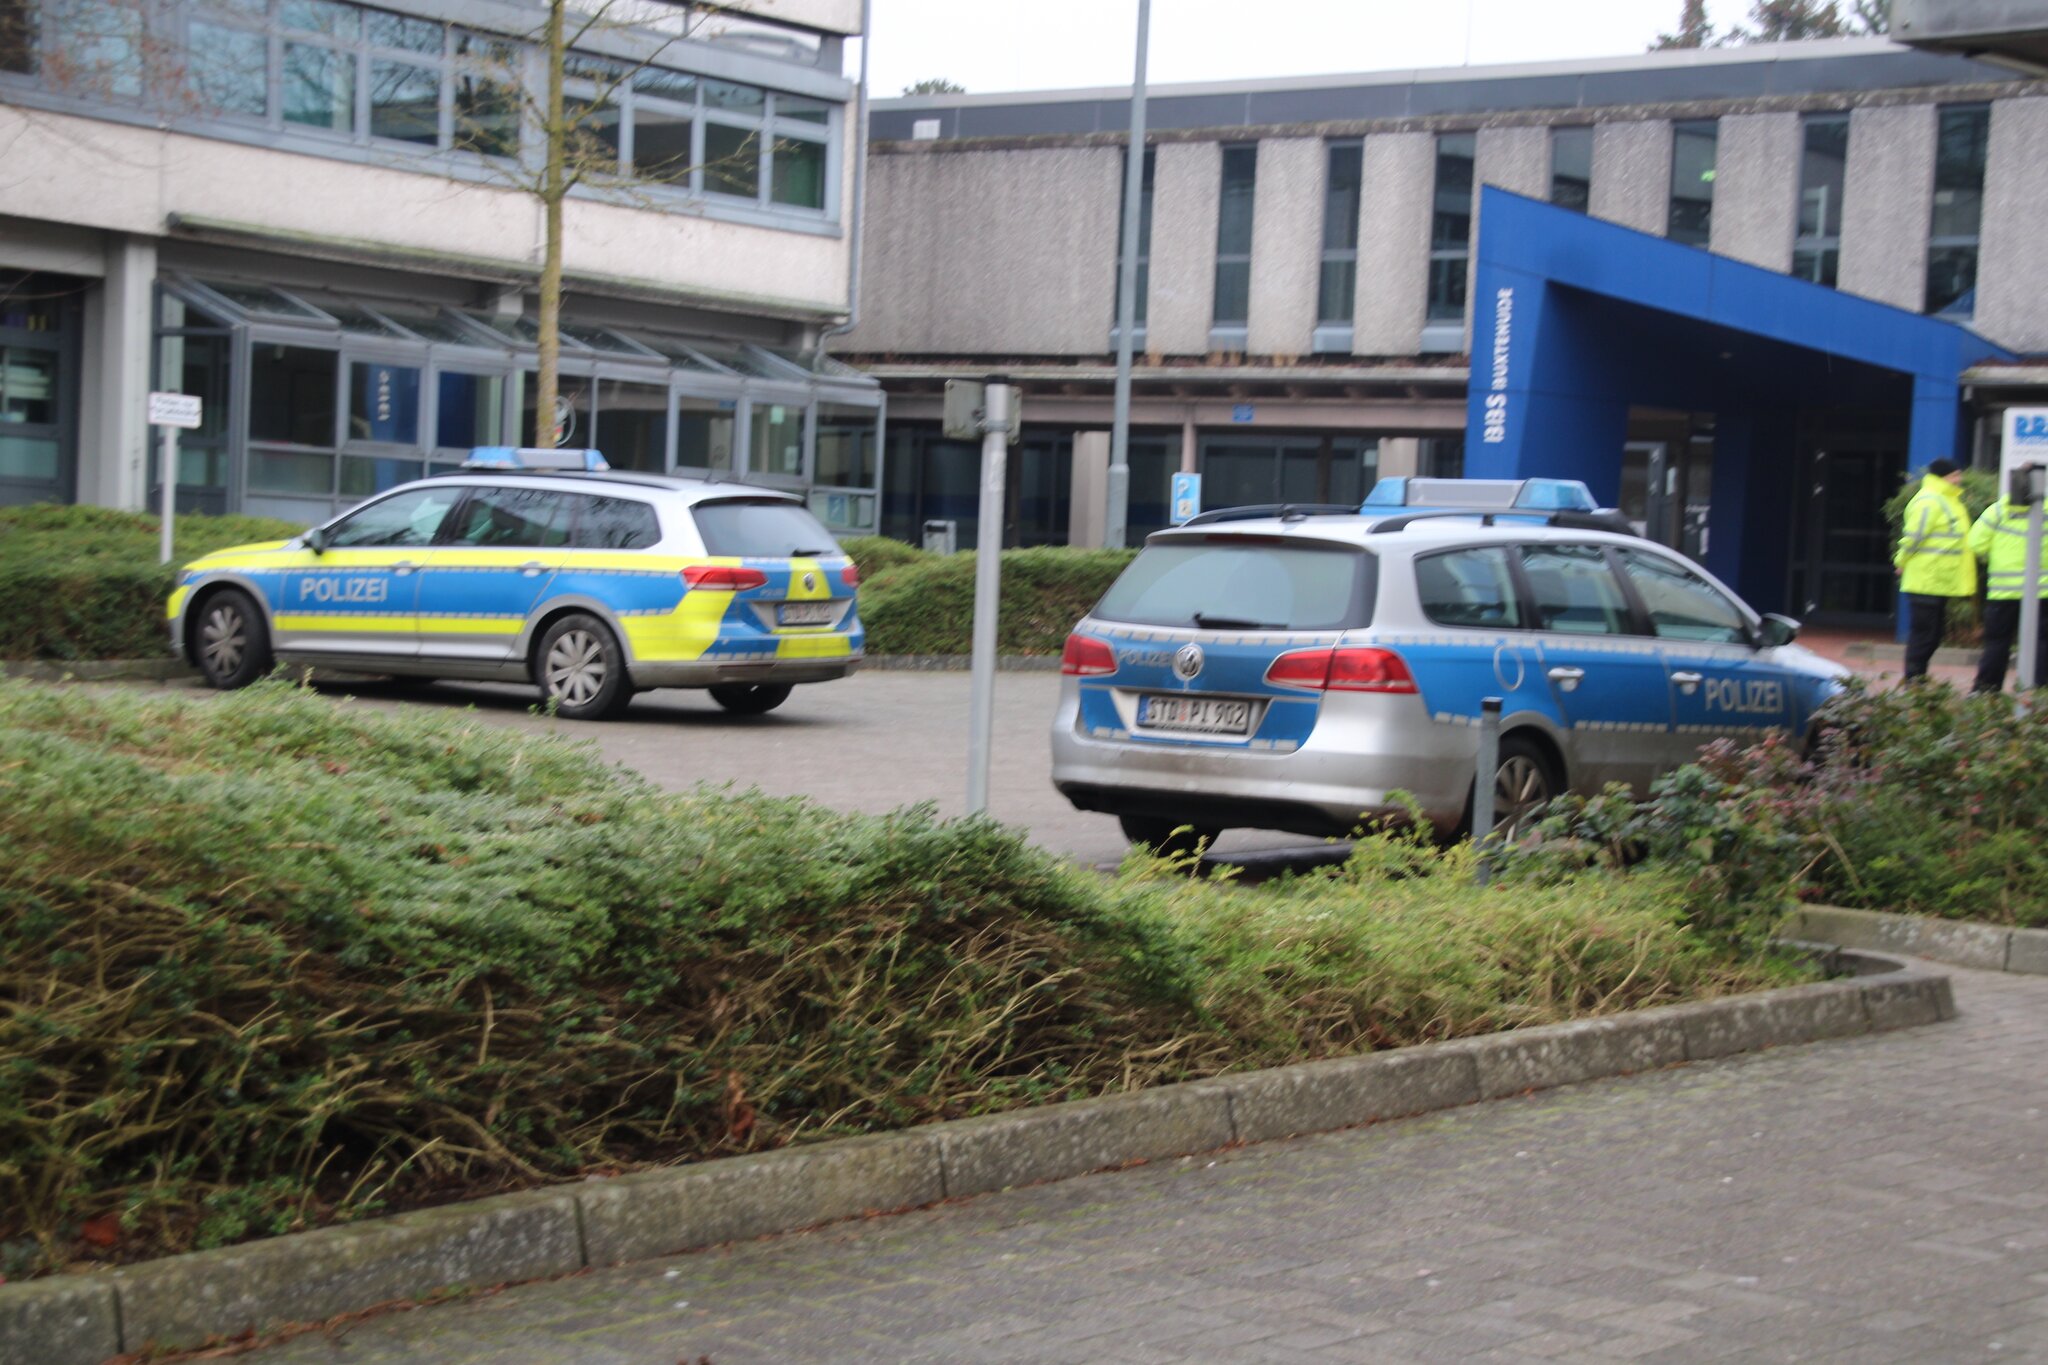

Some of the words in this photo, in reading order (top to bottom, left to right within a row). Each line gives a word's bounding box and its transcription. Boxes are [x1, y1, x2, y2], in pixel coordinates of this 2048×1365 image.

[1483, 394, 1506, 443] BBS
[300, 576, 388, 602] POLIZEI
[1704, 677, 1784, 713] POLIZEI
